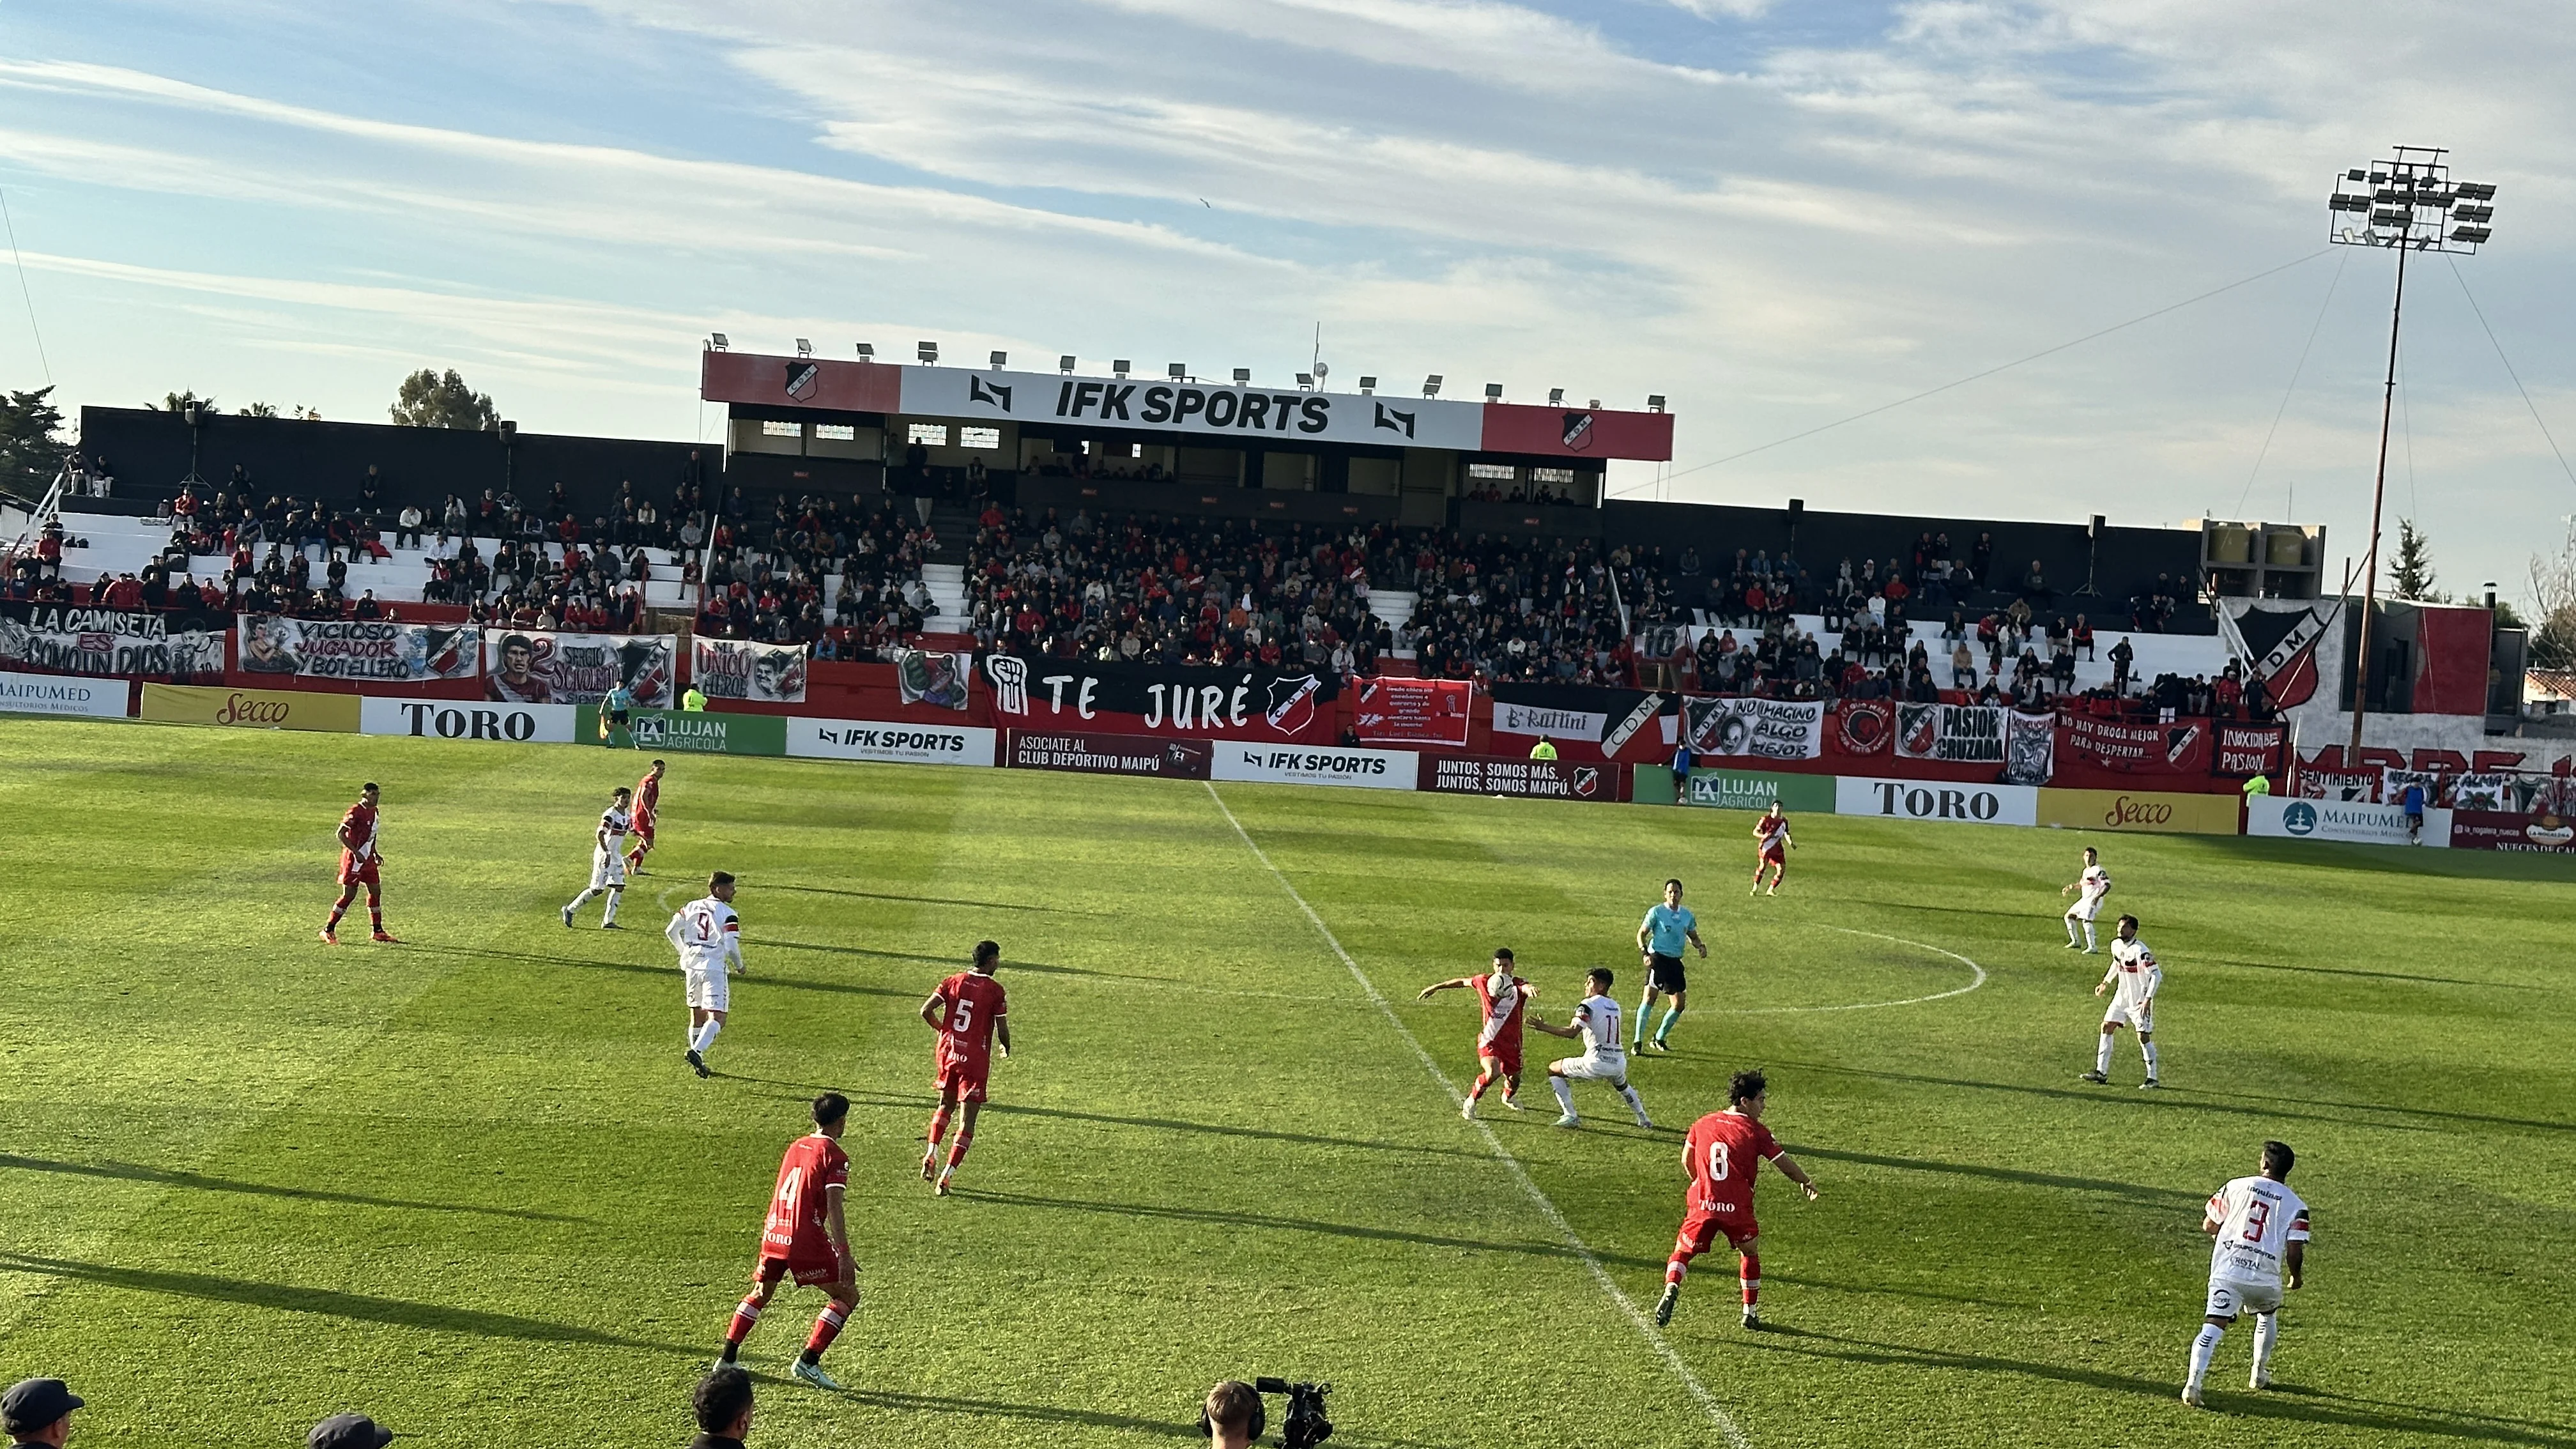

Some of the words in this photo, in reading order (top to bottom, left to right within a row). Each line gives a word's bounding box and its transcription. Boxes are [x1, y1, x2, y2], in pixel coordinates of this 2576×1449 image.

[1055, 380, 1139, 420] IFK
[1140, 387, 1330, 433] SPORTS
[27, 607, 60, 632] LA
[65, 609, 167, 641] CAMISETA
[295, 622, 398, 640] VICIOSO
[78, 633, 116, 651] ES
[293, 640, 400, 657] JUGADOR
[27, 636, 80, 673] COMO
[84, 650, 112, 673] UN
[118, 643, 168, 673] DIOS
[295, 653, 307, 670] Y
[312, 656, 411, 678] BOTELLERO
[563, 646, 605, 667] SERGIO
[1043, 675, 1098, 719] TE
[1144, 673, 1252, 730] JURÉ
[1736, 700, 1756, 714] NO
[1759, 703, 1816, 721] IMAGINO
[401, 703, 535, 740] TORO
[670, 719, 726, 738] LUJAN
[1757, 721, 1807, 739] ALGO
[1942, 707, 1999, 738] PASION
[2062, 715, 2073, 727] NO
[2076, 719, 2094, 733] HAY
[2097, 724, 2126, 740] DROGA
[2130, 730, 2159, 742] MEJOR
[666, 736, 726, 751] AGRICOLA
[845, 729, 879, 746] IFK
[881, 731, 965, 751] SPORTS
[1019, 736, 1071, 751] ASOCIATE
[1073, 739, 1086, 752] AL
[1751, 740, 1808, 756] MEJOR
[1936, 738, 2004, 760] CRUZADA
[2070, 734, 2092, 749] PARA
[1018, 750, 1048, 765] CLUB
[1052, 753, 1117, 769] DEPORTIVO
[1121, 754, 1160, 771] MAIPÚ
[1269, 752, 1303, 769] IFK
[1304, 755, 1386, 774] SPORTS
[1437, 760, 1483, 777] JUNTOS,
[1487, 763, 1527, 778] SOMOS
[1531, 763, 1559, 780] MÁS.
[1436, 774, 1482, 792] JUNTOS,
[1485, 777, 1526, 793] SOMOS
[1529, 779, 1570, 796] MAIPÚ.
[1722, 778, 1777, 796] LUJAN
[1719, 795, 1774, 809] AGRICOL
[1874, 782, 1999, 820] TORO
[697, 912, 709, 940] 9
[953, 999, 974, 1032] 5
[1606, 1015, 1620, 1044] 11
[1710, 1142, 1729, 1181] 8
[779, 1167, 802, 1210] 4
[2242, 1200, 2269, 1242] 3
